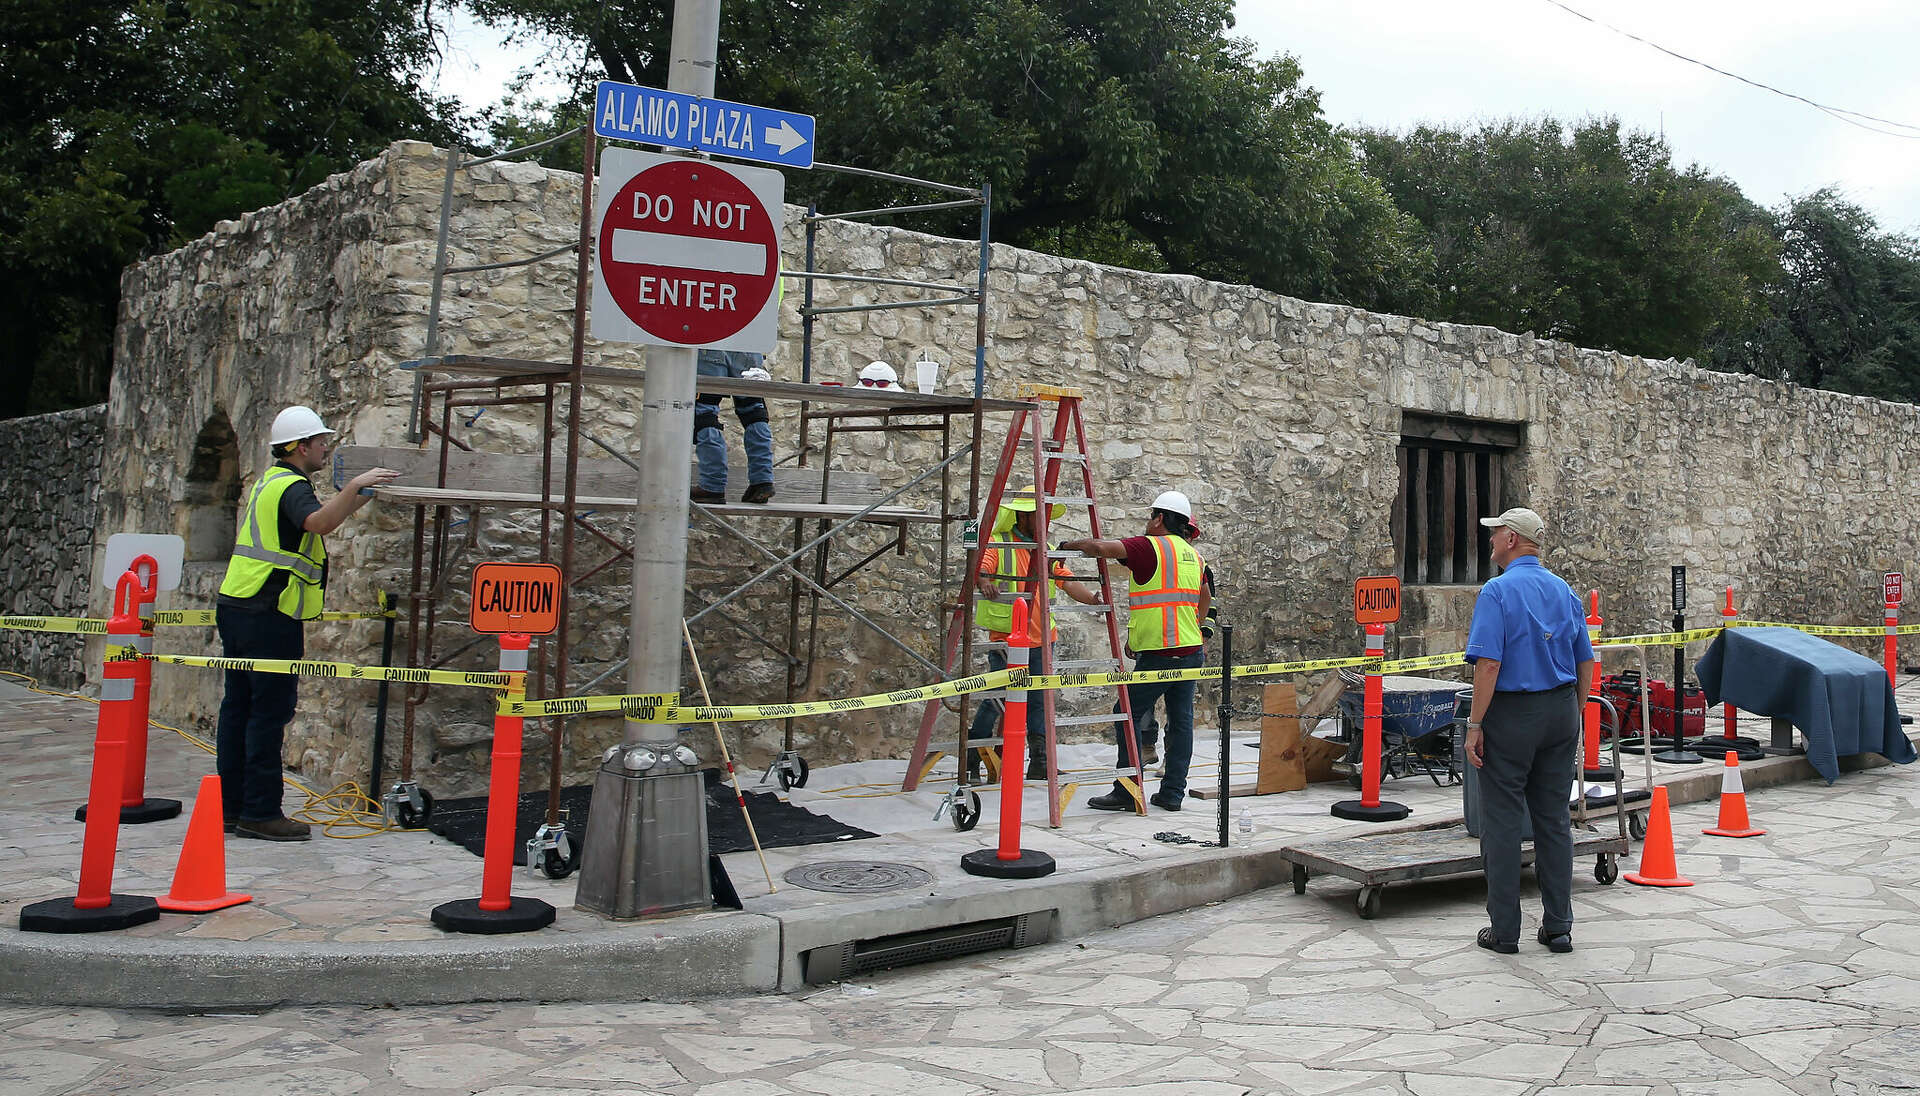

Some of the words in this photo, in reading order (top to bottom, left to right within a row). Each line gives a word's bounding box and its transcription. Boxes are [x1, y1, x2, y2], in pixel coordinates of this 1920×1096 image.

[601, 90, 679, 140] ALAMO
[687, 103, 754, 151] PLAZA
[633, 191, 674, 222] DO
[693, 199, 751, 231] NOT
[639, 275, 737, 312] ENTER
[479, 579, 553, 613] CAUTION
[1358, 587, 1397, 611] CAUTION
[206, 659, 255, 672] CAUTION
[289, 662, 337, 677] CUIDADO
[384, 668, 431, 683] CAUTION
[1059, 673, 1088, 686] CAUTION
[1106, 671, 1134, 683] CUIDADO
[544, 699, 588, 715] CAUTION
[695, 706, 734, 721] CAUTION
[757, 704, 797, 717] CUIDADO
[828, 697, 866, 712] CAUTION
[887, 689, 924, 703] CUIDADO
[953, 676, 987, 693] CAUTION
